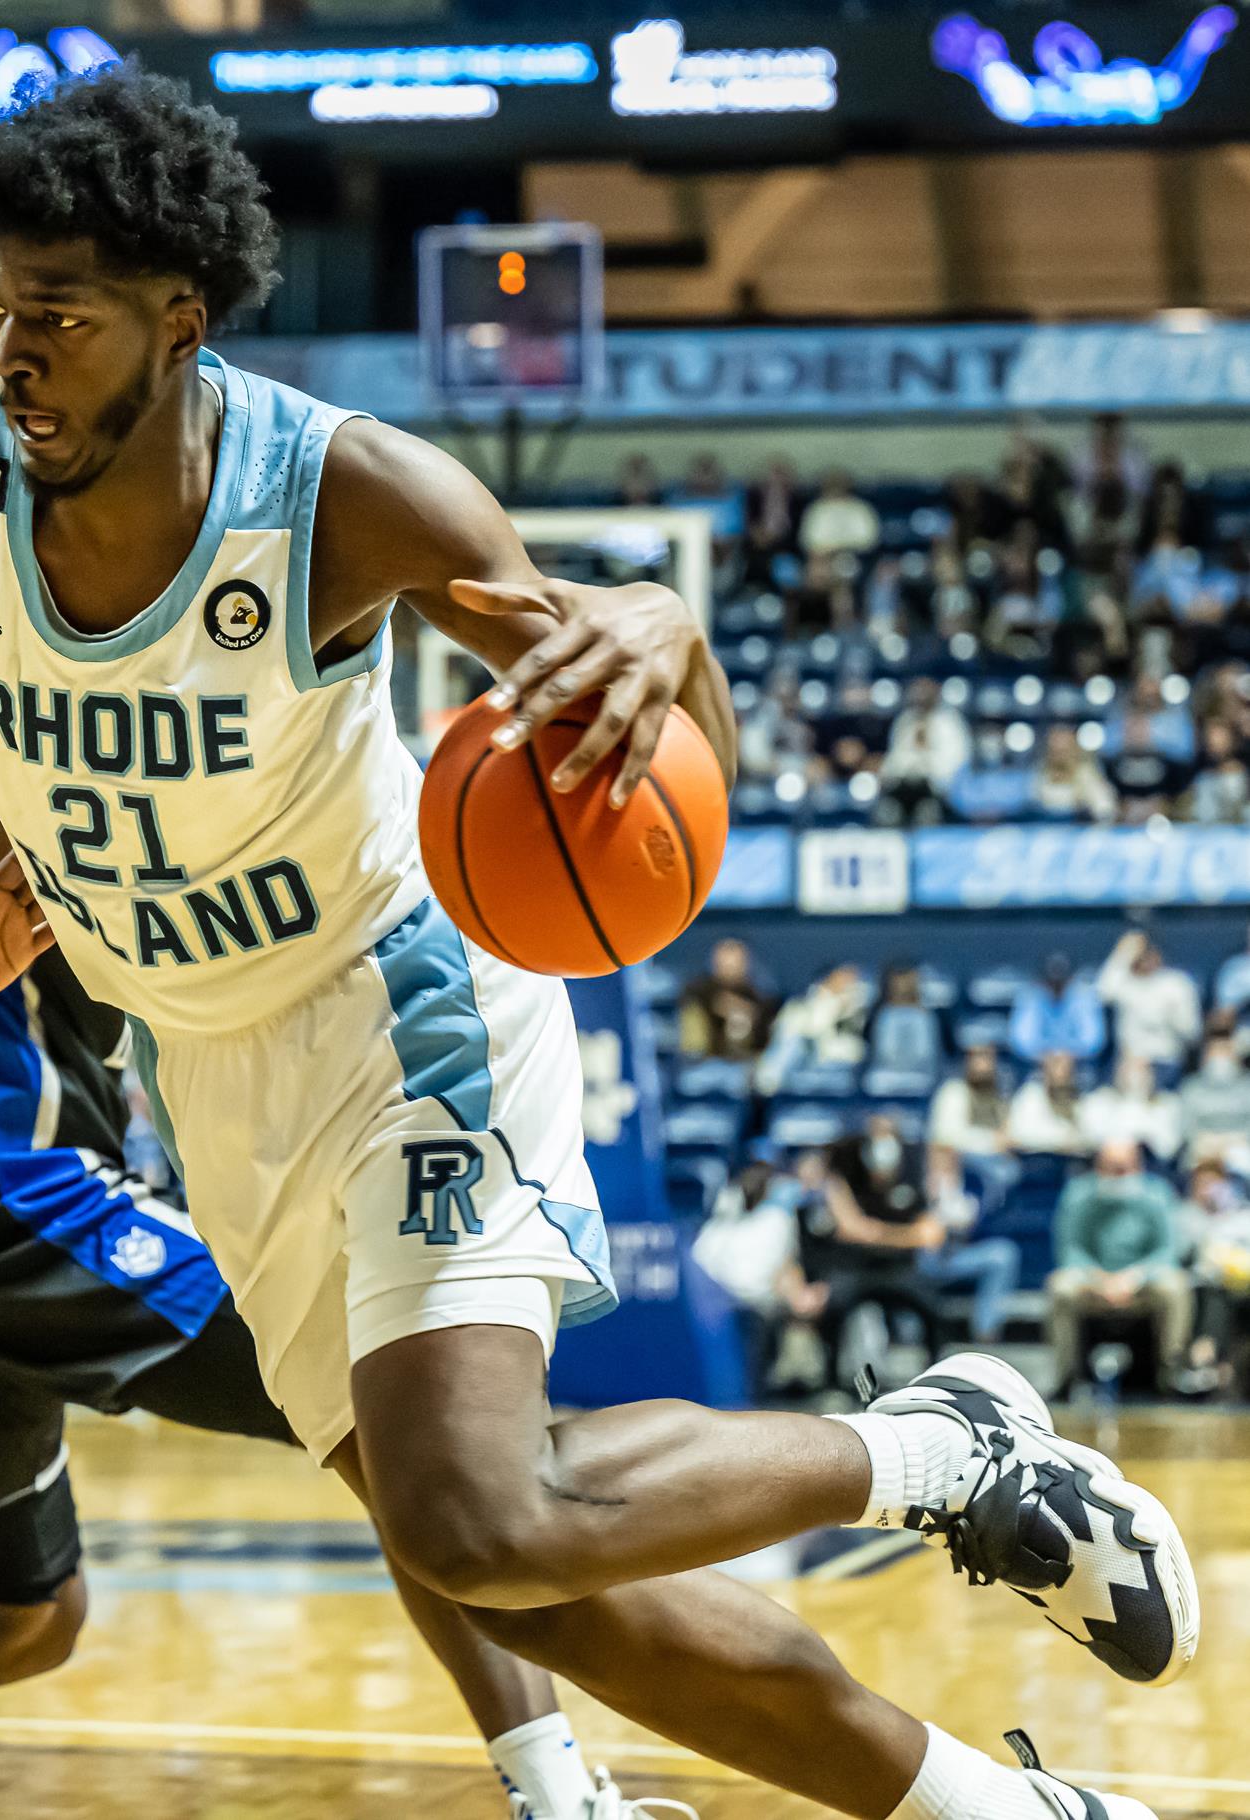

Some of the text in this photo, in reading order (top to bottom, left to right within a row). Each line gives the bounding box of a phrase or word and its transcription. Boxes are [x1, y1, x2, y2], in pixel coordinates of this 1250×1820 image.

[606, 344, 1020, 392] TUDENT
[215, 633, 238, 647] United
[250, 627, 264, 641] One
[47, 783, 190, 887] 21
